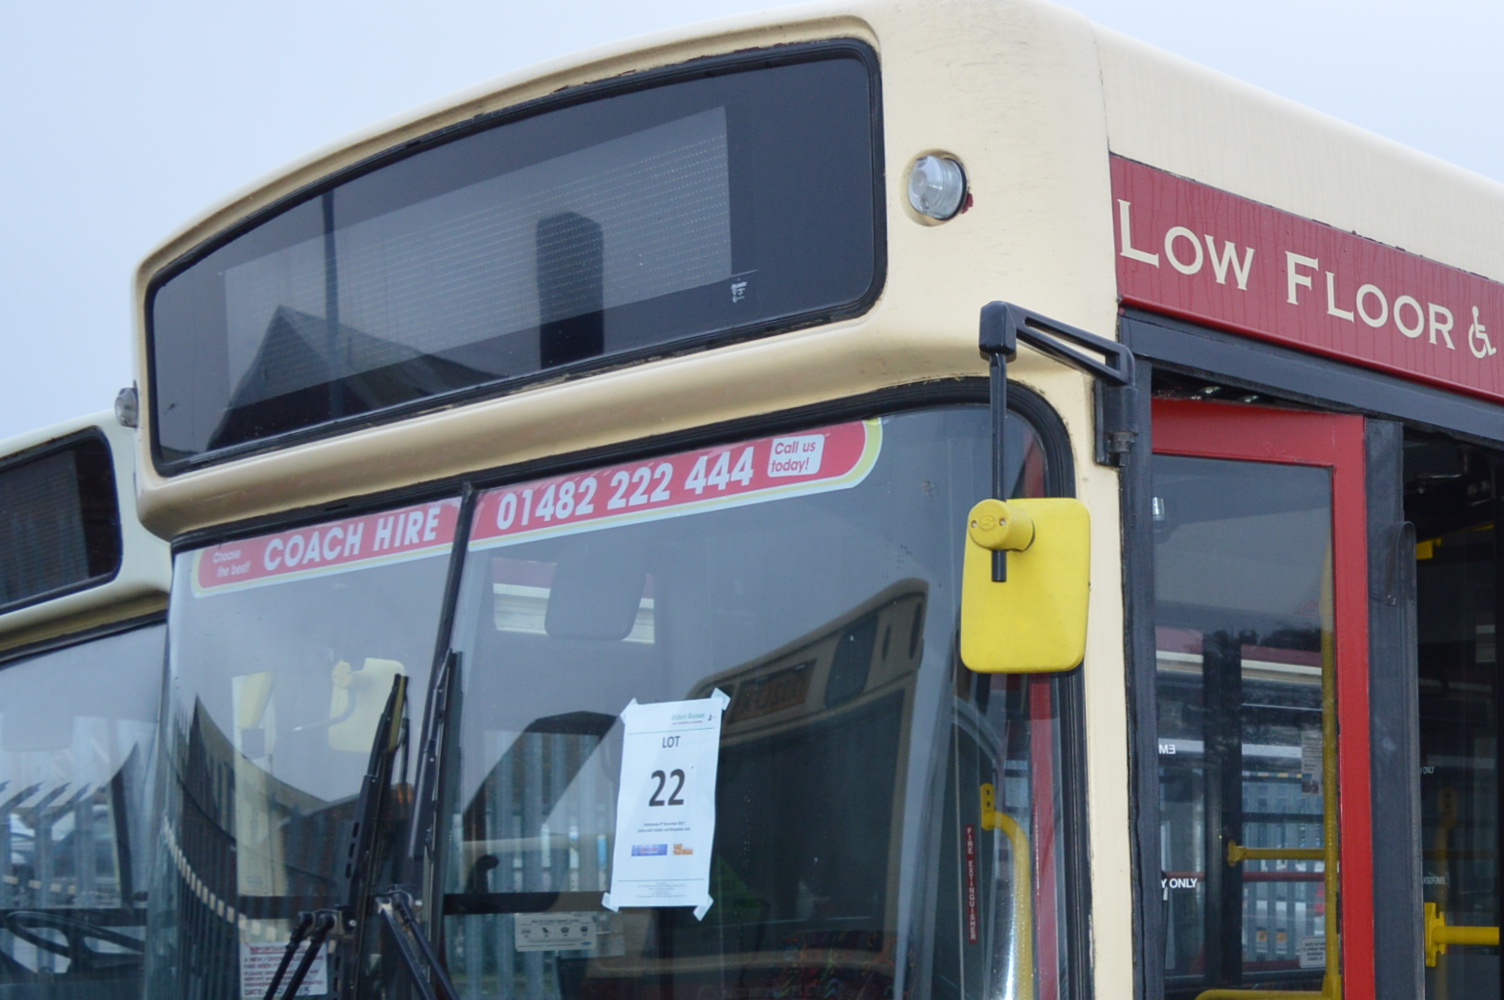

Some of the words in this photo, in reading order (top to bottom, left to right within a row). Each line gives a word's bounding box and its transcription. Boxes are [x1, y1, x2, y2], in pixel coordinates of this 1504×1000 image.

[1117, 198, 1255, 291] LOW
[1285, 250, 1456, 350] FLOOR
[774, 440, 799, 455] Call
[802, 440, 816, 454] us
[770, 457, 810, 474] today!
[496, 476, 597, 529] 01482
[607, 462, 674, 511] 222
[685, 445, 755, 495] 444
[263, 521, 365, 571] COACH
[373, 506, 441, 552] HIRE
[212, 549, 242, 564] Choose
[216, 565, 230, 578] the
[662, 735, 681, 749] LOT
[648, 768, 686, 808] 22
[966, 826, 974, 855] FIRE
[1169, 878, 1198, 889] ONLY
[967, 859, 977, 941] EXTINGUISHER
